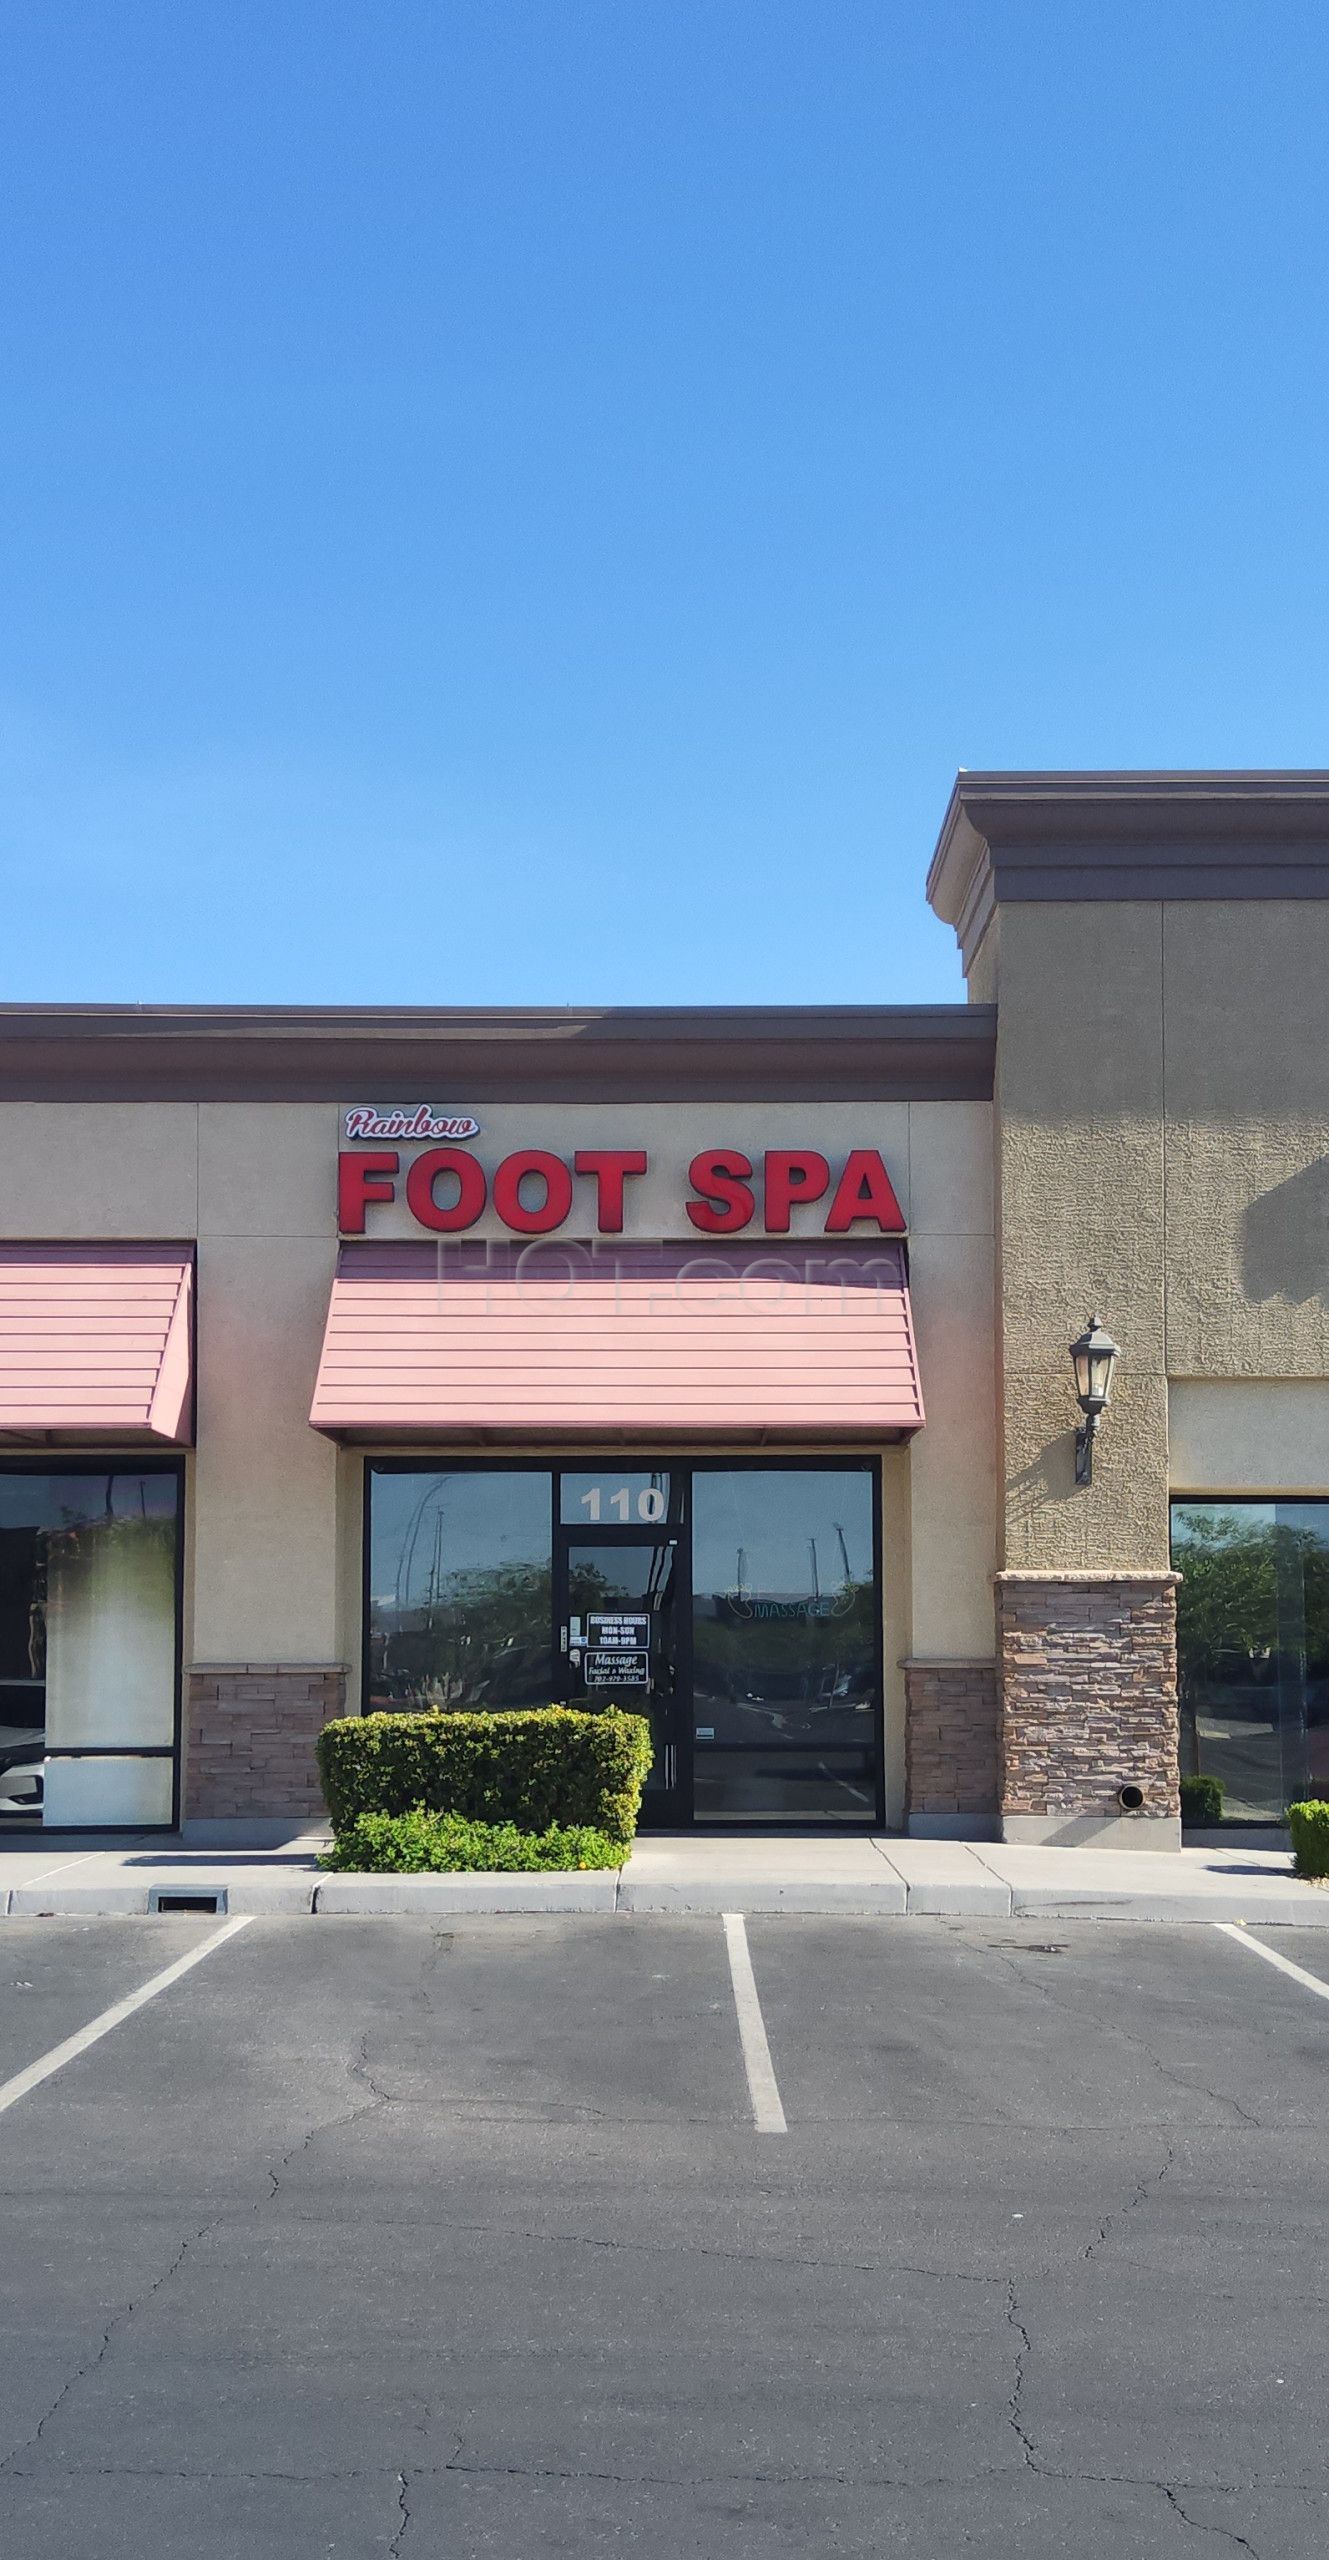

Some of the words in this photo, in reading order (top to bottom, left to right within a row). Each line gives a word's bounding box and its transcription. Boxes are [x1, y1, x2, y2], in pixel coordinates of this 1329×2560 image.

[346, 1104, 479, 1139] Rainbow
[338, 1148, 647, 1233] FOOT
[686, 1149, 907, 1233] SPA
[581, 1488, 664, 1521] 110
[754, 1602, 831, 1617] MASSAGE
[590, 1616, 622, 1625] BUSINESS
[623, 1616, 647, 1625] HOURS
[601, 1626, 635, 1635] MON-SUN
[595, 1653, 638, 1667] Massage
[588, 1667, 610, 1675] Facial
[618, 1666, 645, 1676] Waxing
